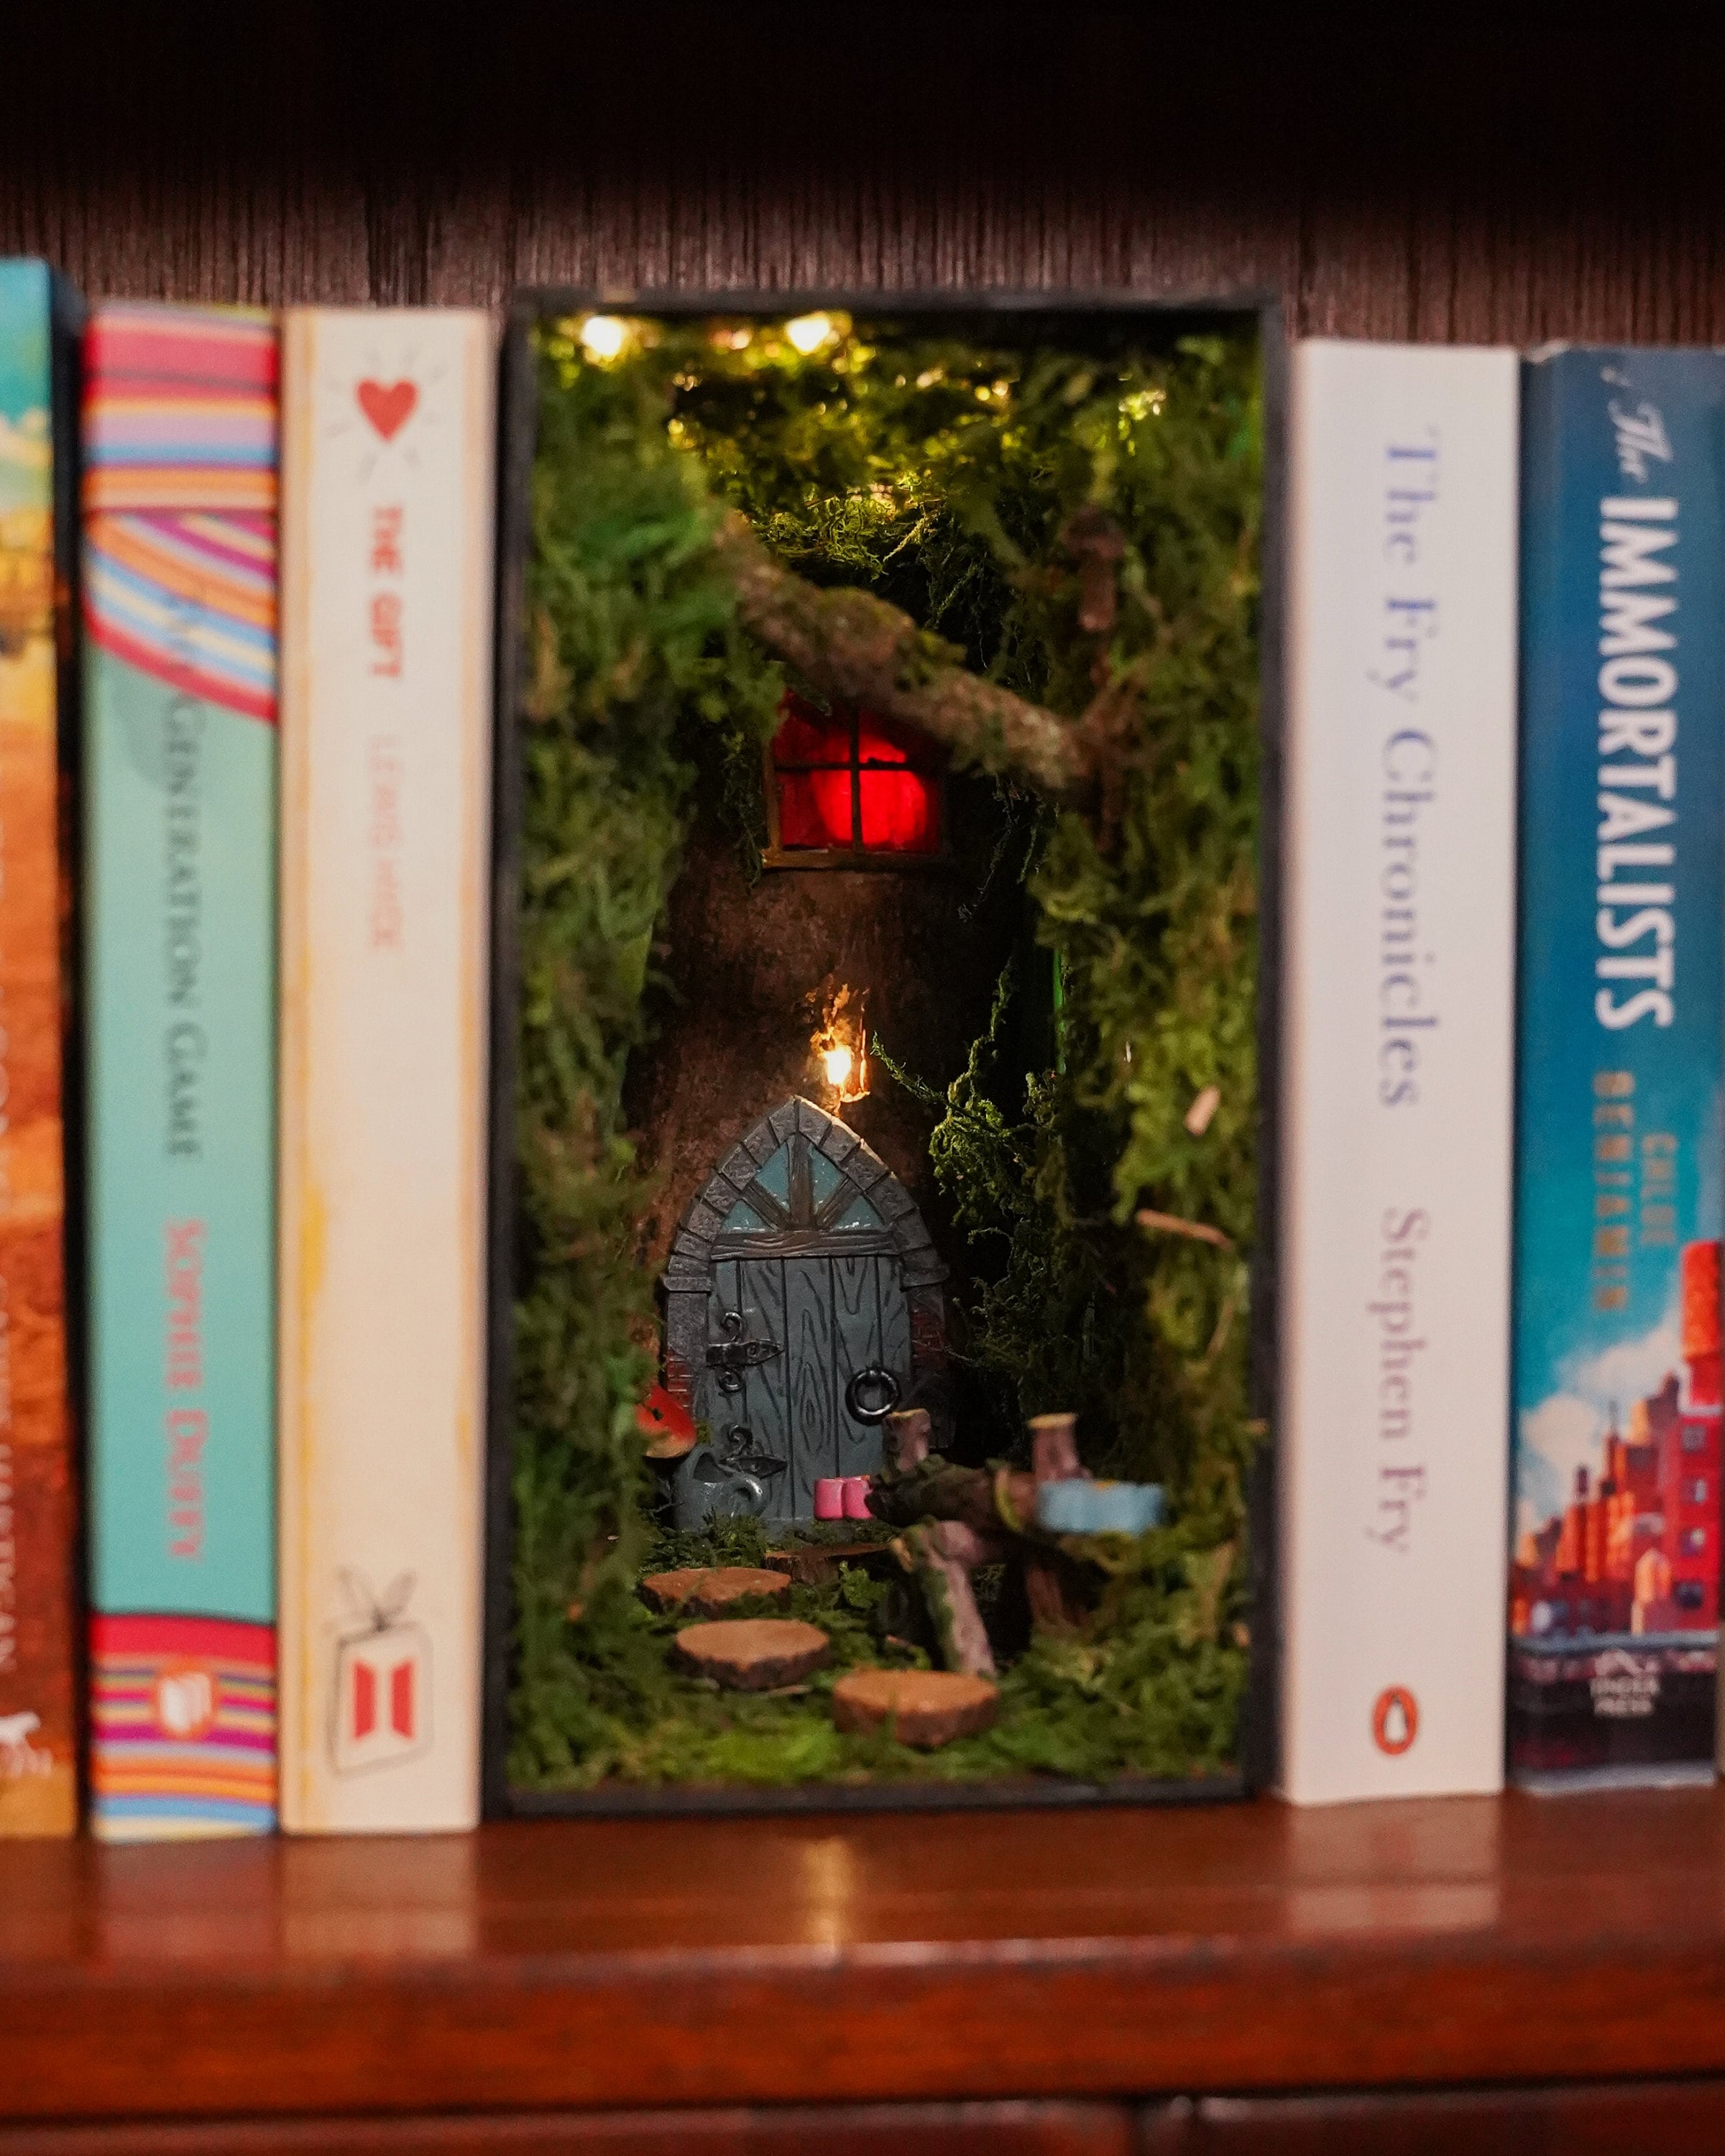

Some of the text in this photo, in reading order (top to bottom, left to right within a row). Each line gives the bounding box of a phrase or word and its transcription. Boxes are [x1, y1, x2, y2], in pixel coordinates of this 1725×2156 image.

[370, 505, 403, 678] THE GIFT
[1366, 425, 1440, 1108] The Fry Chronicles
[1594, 399, 1680, 1031] The IMMORTALISTS
[1364, 1207, 1430, 1554] Stephen Fry
